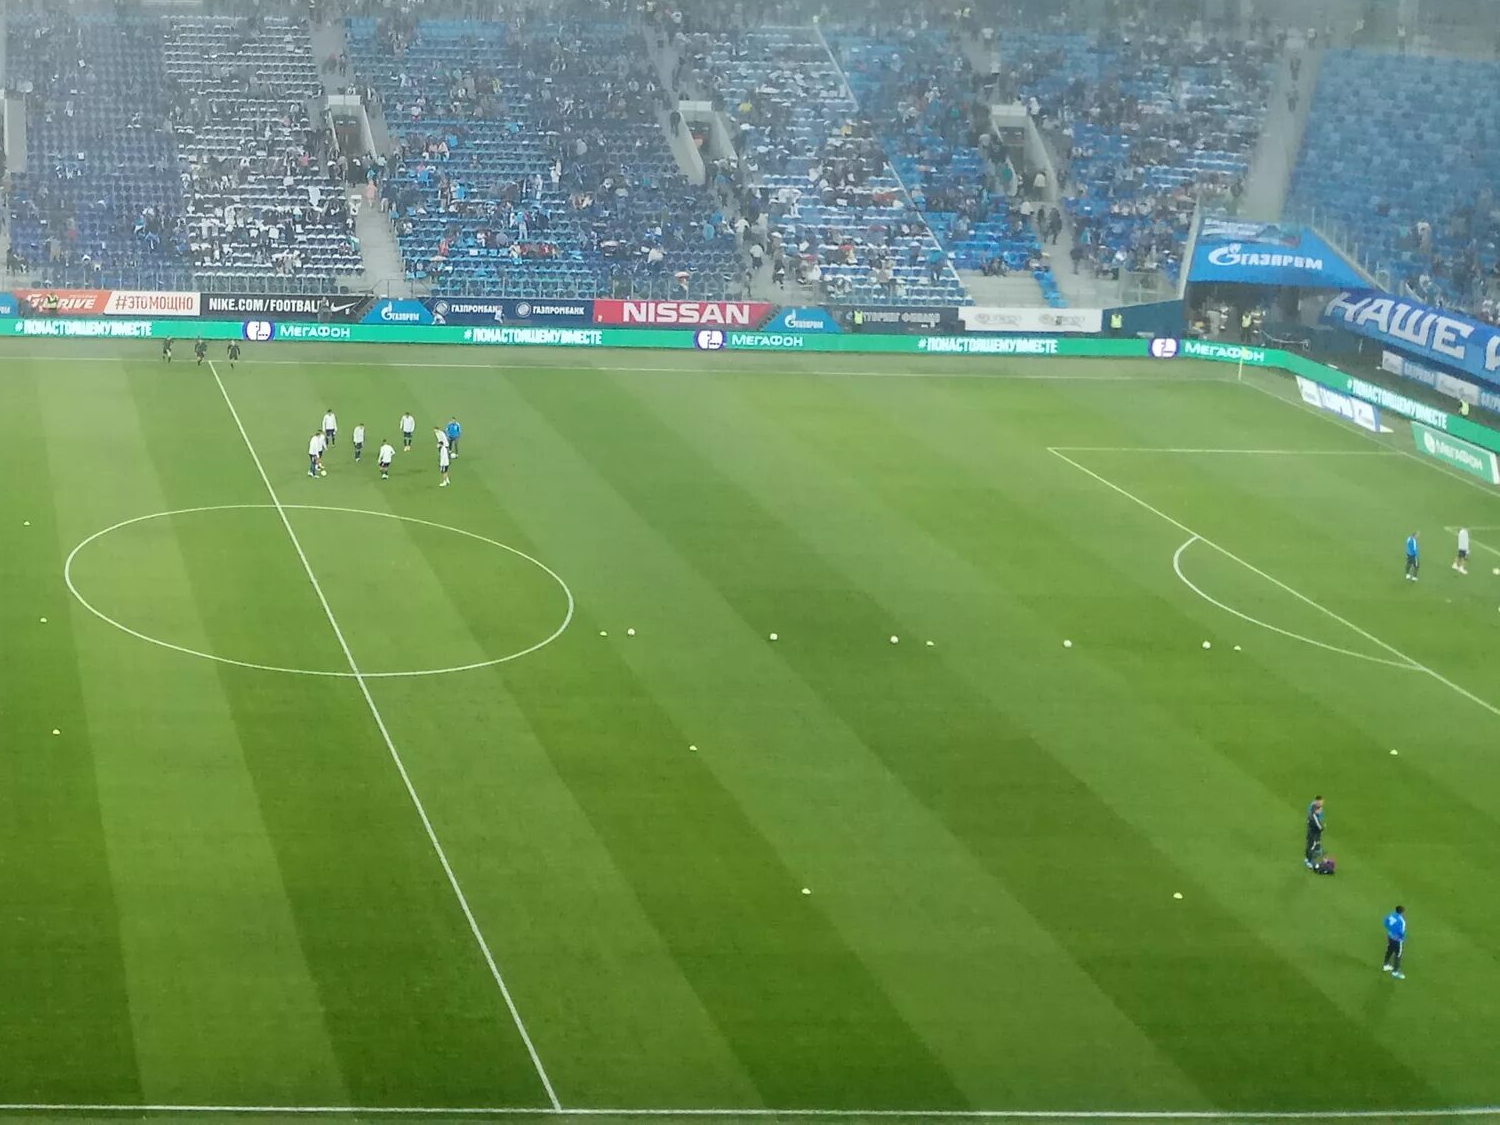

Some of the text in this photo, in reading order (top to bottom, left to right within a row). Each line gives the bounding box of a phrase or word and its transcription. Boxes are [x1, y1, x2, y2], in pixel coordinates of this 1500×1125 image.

[533, 306, 585, 315] ГАЗПРОМБАНК
[623, 302, 749, 324] NISSAN
[280, 325, 351, 338] МЕГАФОН
[1324, 291, 1475, 360] НАШЕ
[731, 334, 803, 347] МЕГАФОН
